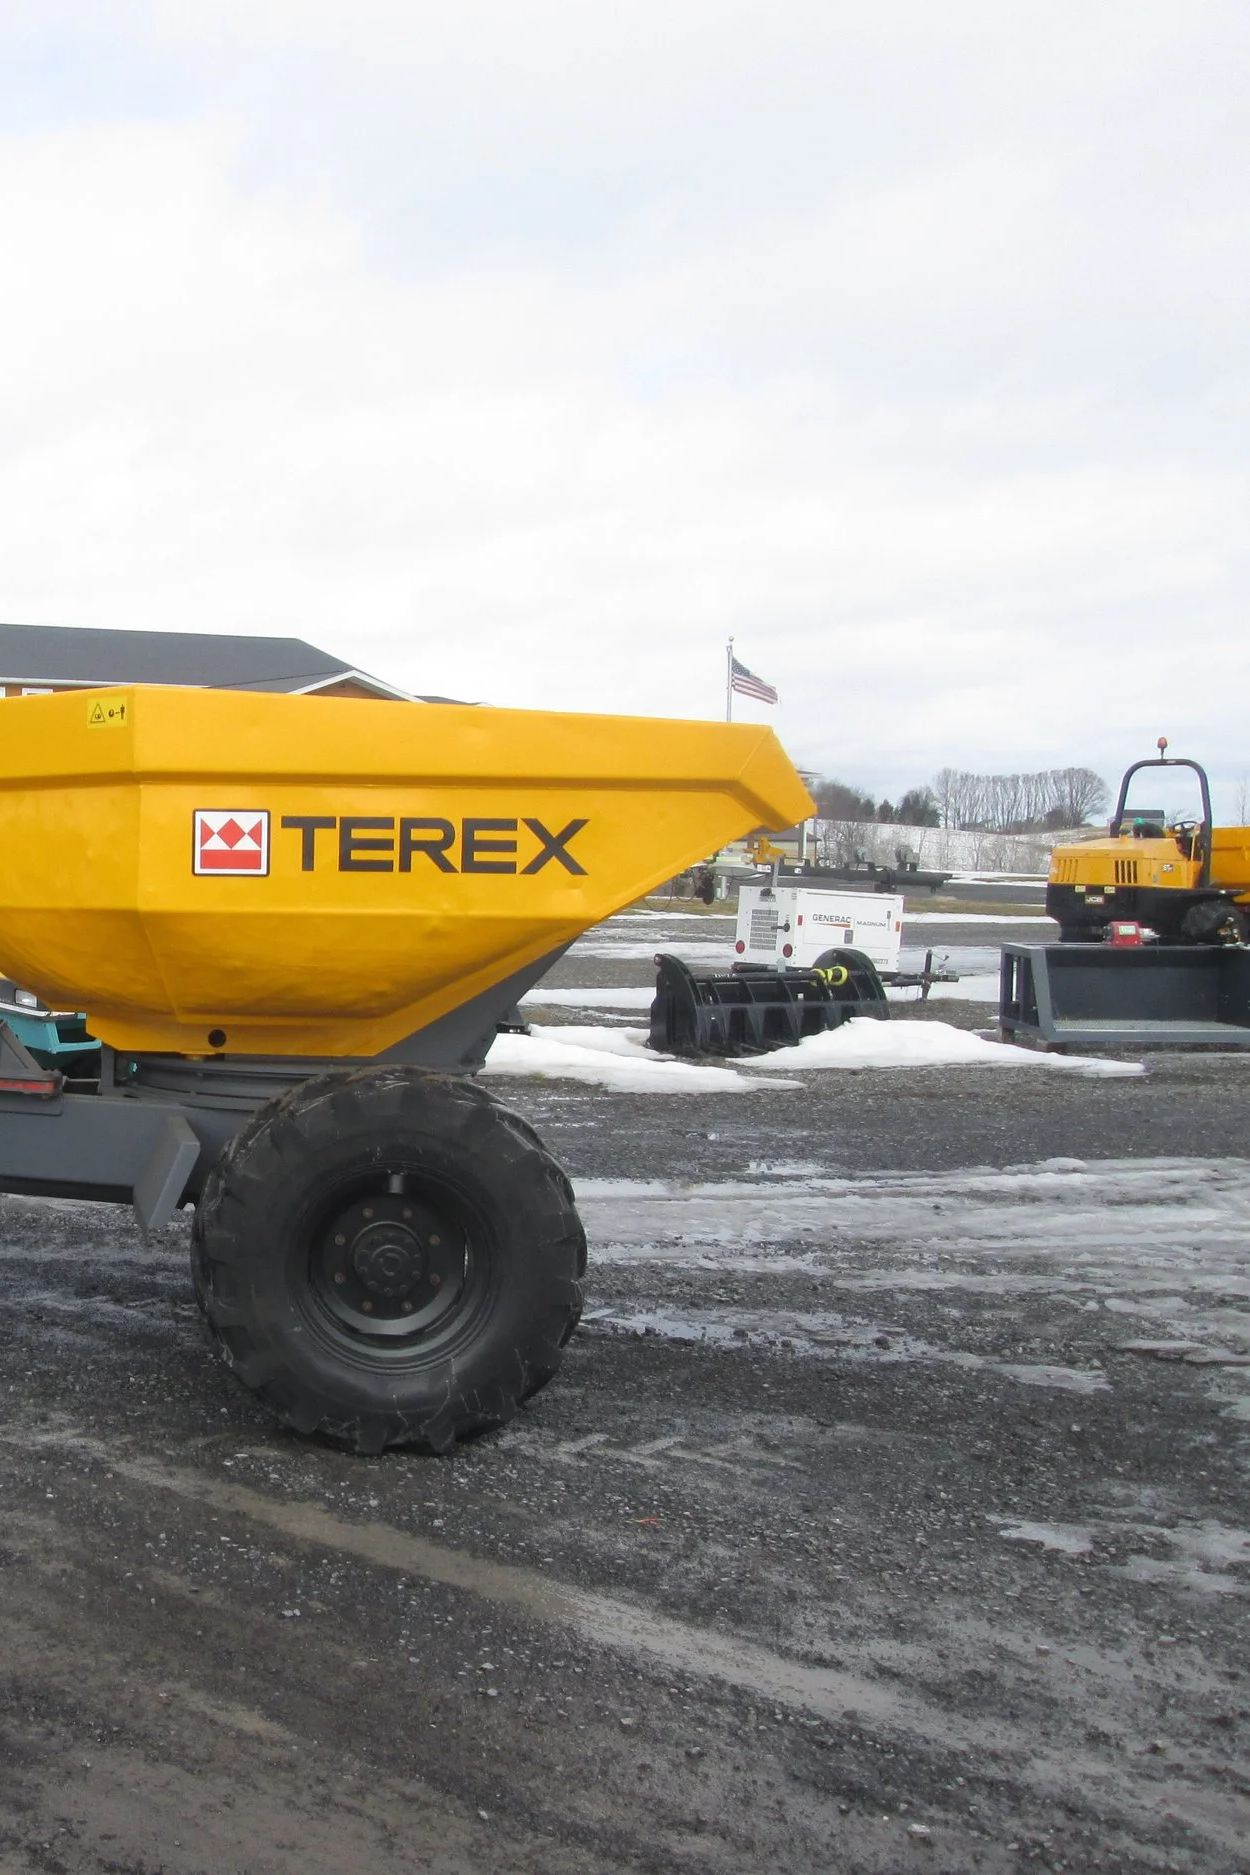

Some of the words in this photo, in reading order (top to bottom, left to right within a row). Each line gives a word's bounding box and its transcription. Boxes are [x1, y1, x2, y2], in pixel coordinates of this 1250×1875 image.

[280, 815, 591, 876] TEREX
[1085, 895, 1103, 903] JCB
[812, 913, 852, 924] GENERAC
[856, 920, 887, 928] MAGNUM
